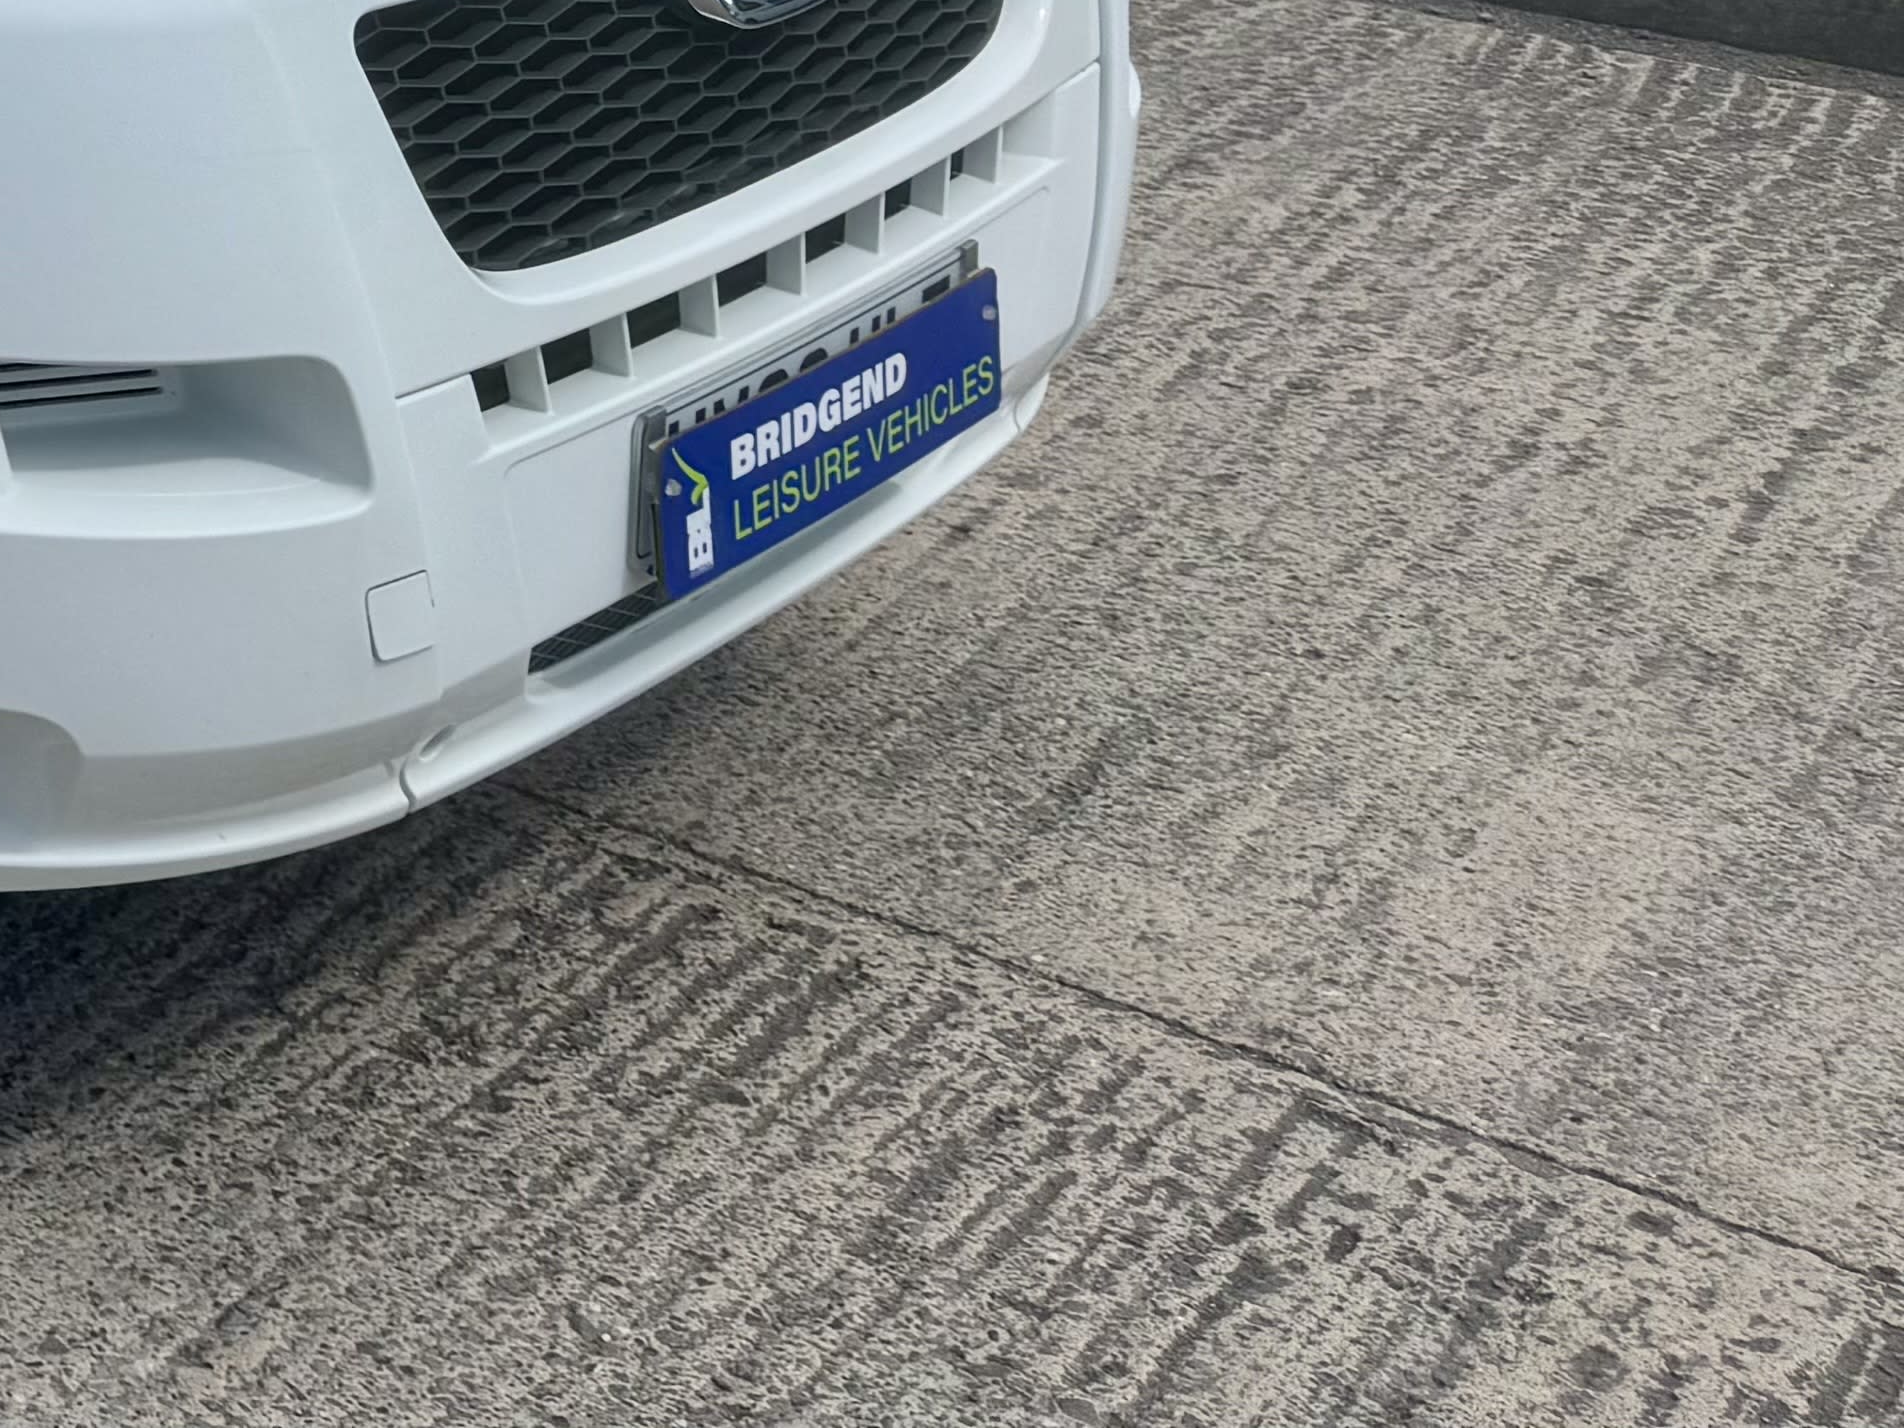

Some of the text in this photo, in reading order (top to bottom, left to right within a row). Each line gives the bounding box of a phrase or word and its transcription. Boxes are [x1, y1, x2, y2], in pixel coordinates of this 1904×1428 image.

[730, 352, 907, 481] BRIDGEND
[733, 434, 862, 541] LEISURE
[866, 355, 995, 464] VEHICLES
